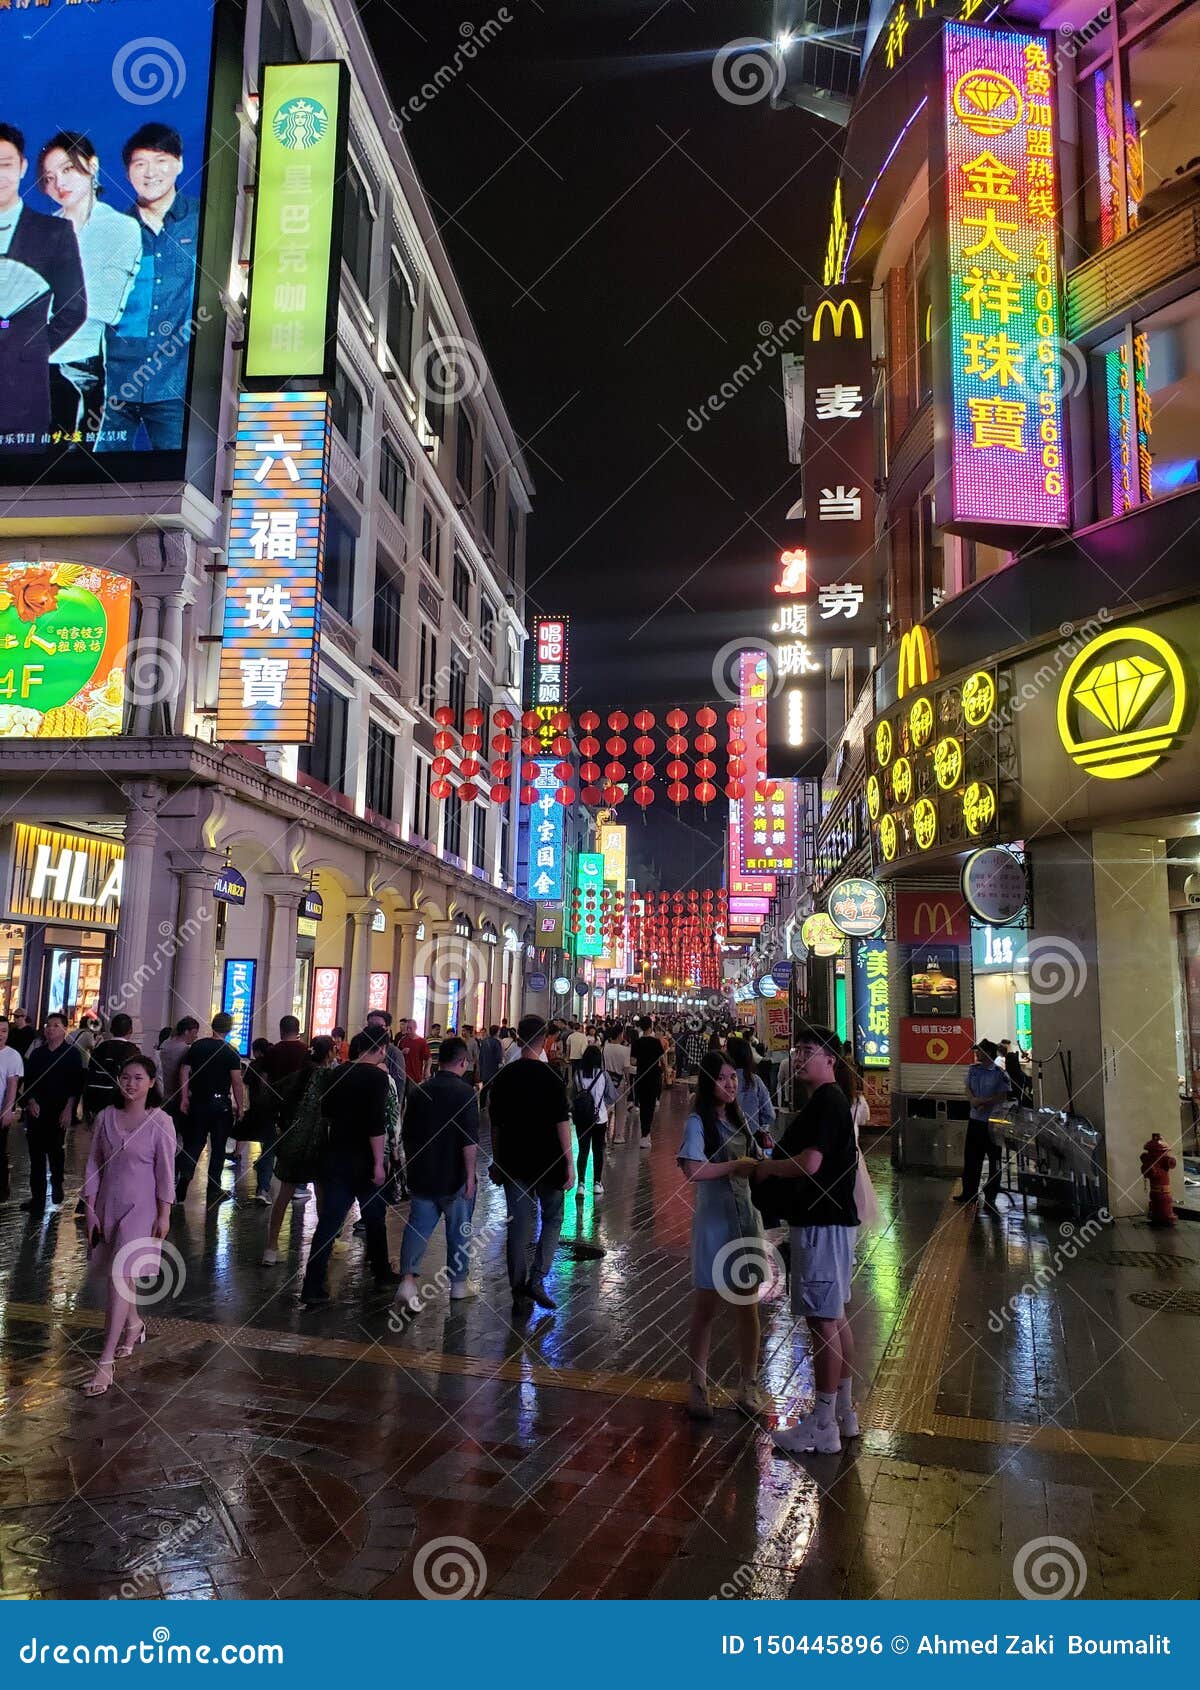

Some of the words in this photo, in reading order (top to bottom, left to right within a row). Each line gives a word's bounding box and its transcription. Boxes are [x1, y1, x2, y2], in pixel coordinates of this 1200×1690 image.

[271, 164, 312, 352] 星巴克咖啡
[961, 151, 1027, 453] 金大祥珠寶
[239, 433, 302, 709] 六福珠寶
[815, 384, 864, 619] 麦当劳
[30, 843, 123, 908] HLA
[866, 949, 890, 1036] 美食城
